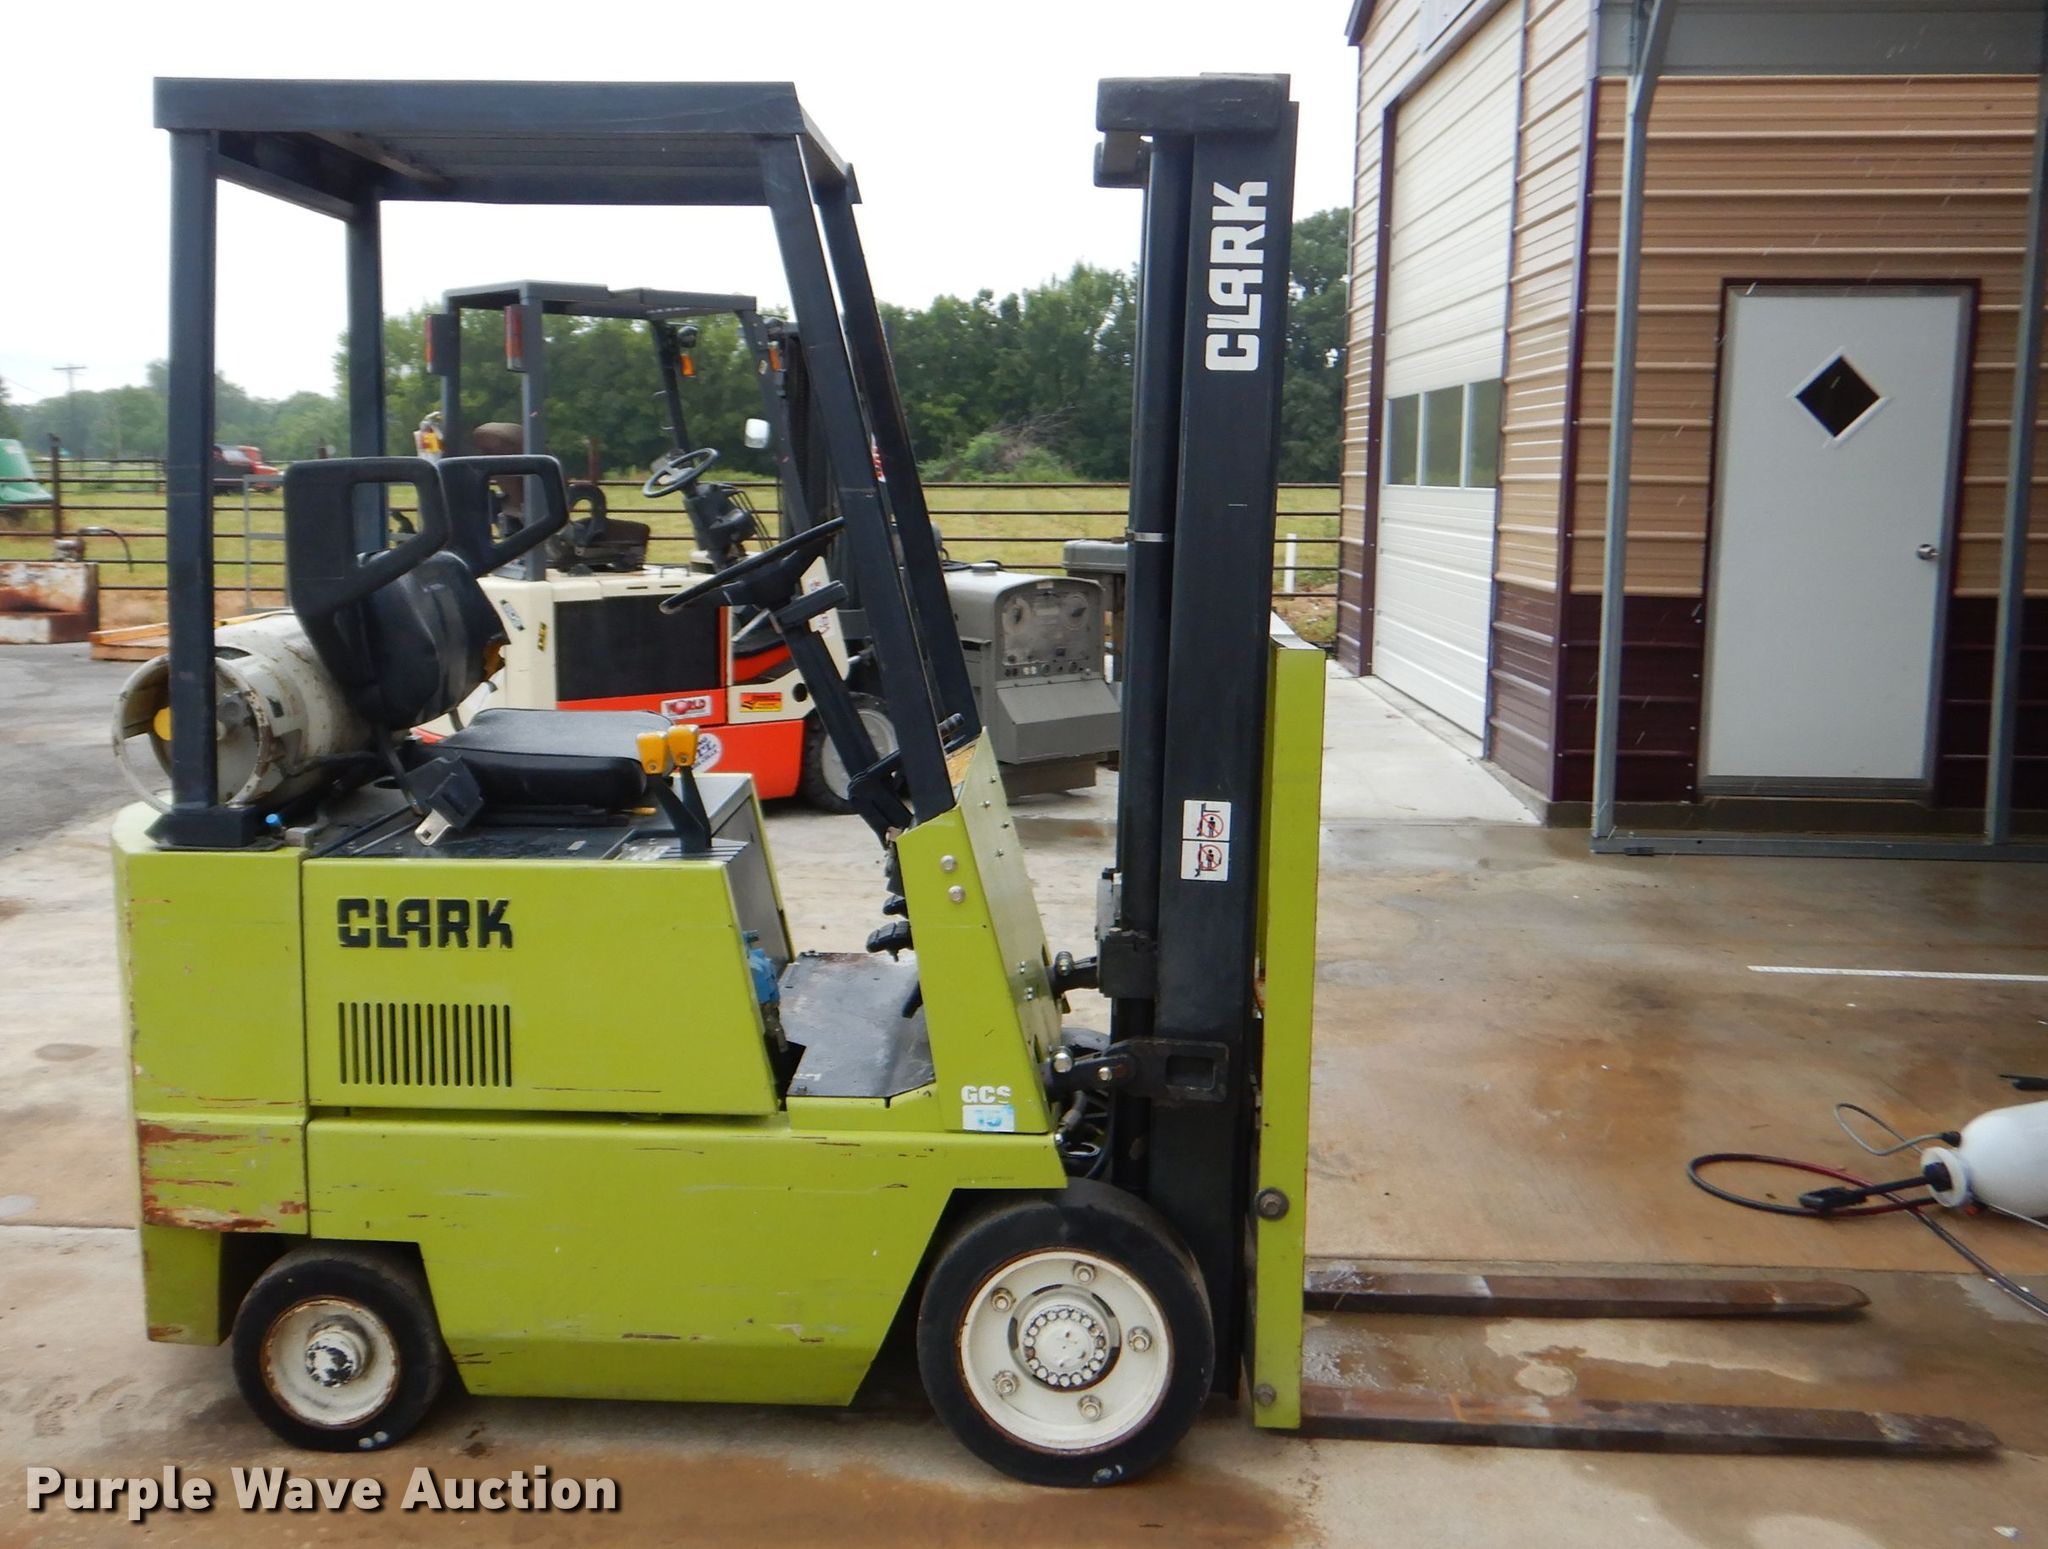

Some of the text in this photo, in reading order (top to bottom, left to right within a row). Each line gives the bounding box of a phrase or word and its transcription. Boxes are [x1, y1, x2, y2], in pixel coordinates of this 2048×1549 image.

[1205, 181, 1268, 371] CLARK
[337, 898, 513, 949] CLARK
[960, 1085, 1012, 1104] GCS
